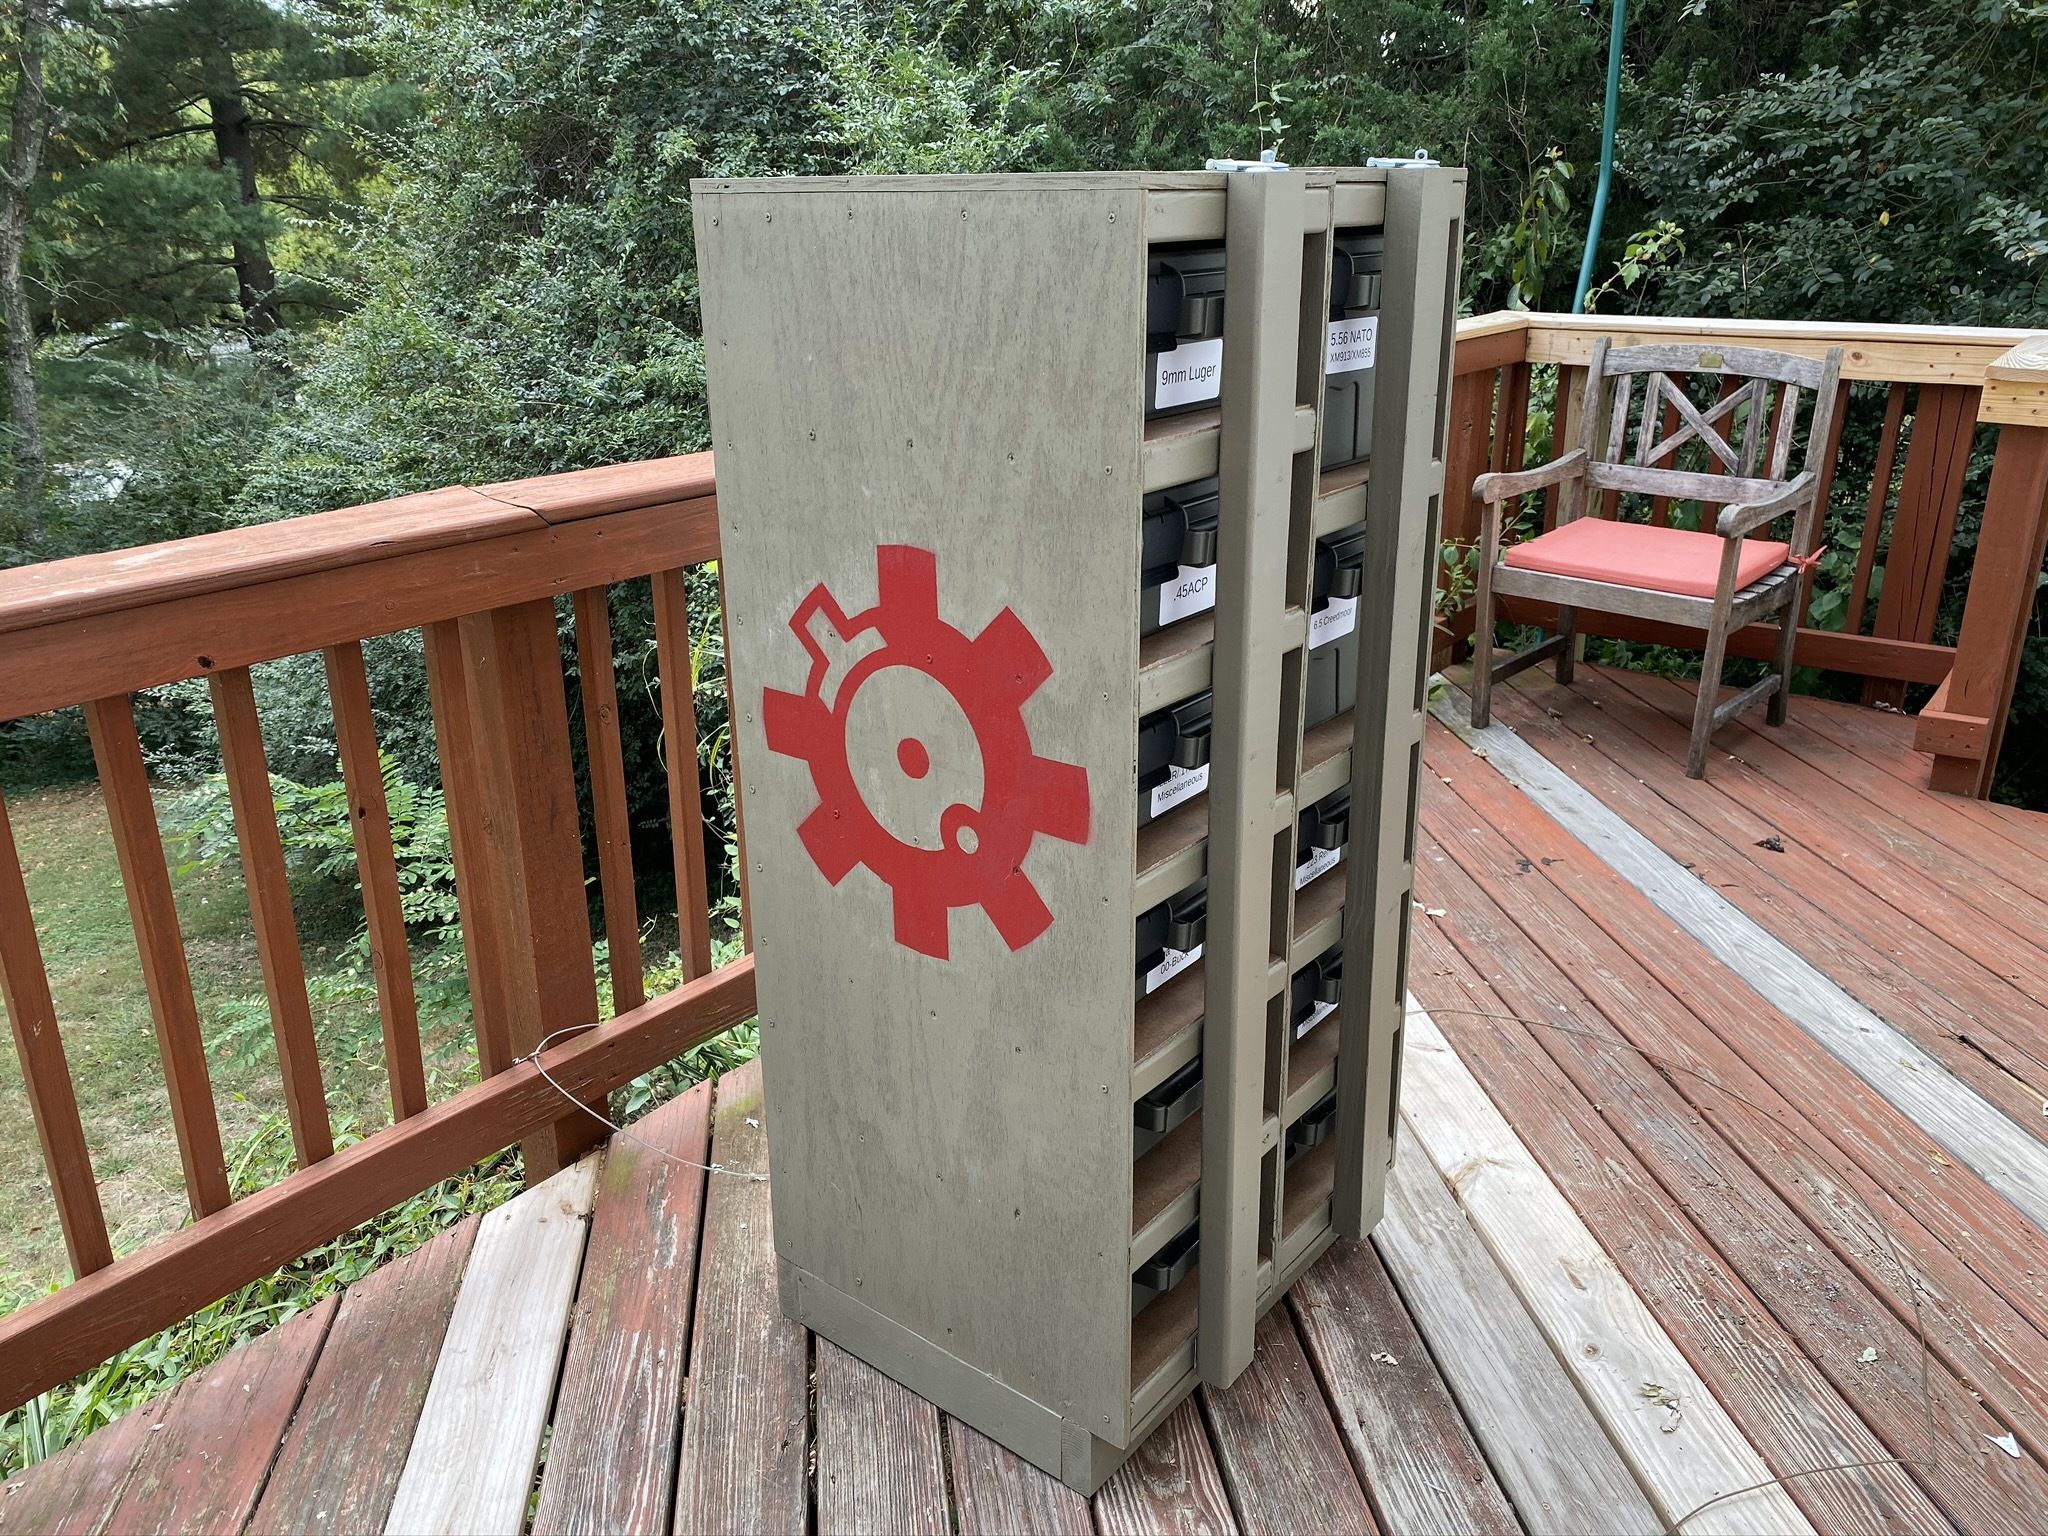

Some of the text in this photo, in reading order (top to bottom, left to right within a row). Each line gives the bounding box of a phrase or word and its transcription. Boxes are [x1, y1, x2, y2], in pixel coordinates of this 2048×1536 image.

[1330, 328, 1373, 346] 5.56 NATO
[1161, 365, 1217, 386] 9mm Luger
[1173, 576, 1208, 601] .45ACP
[1157, 772, 1203, 802] Miscellaneous
